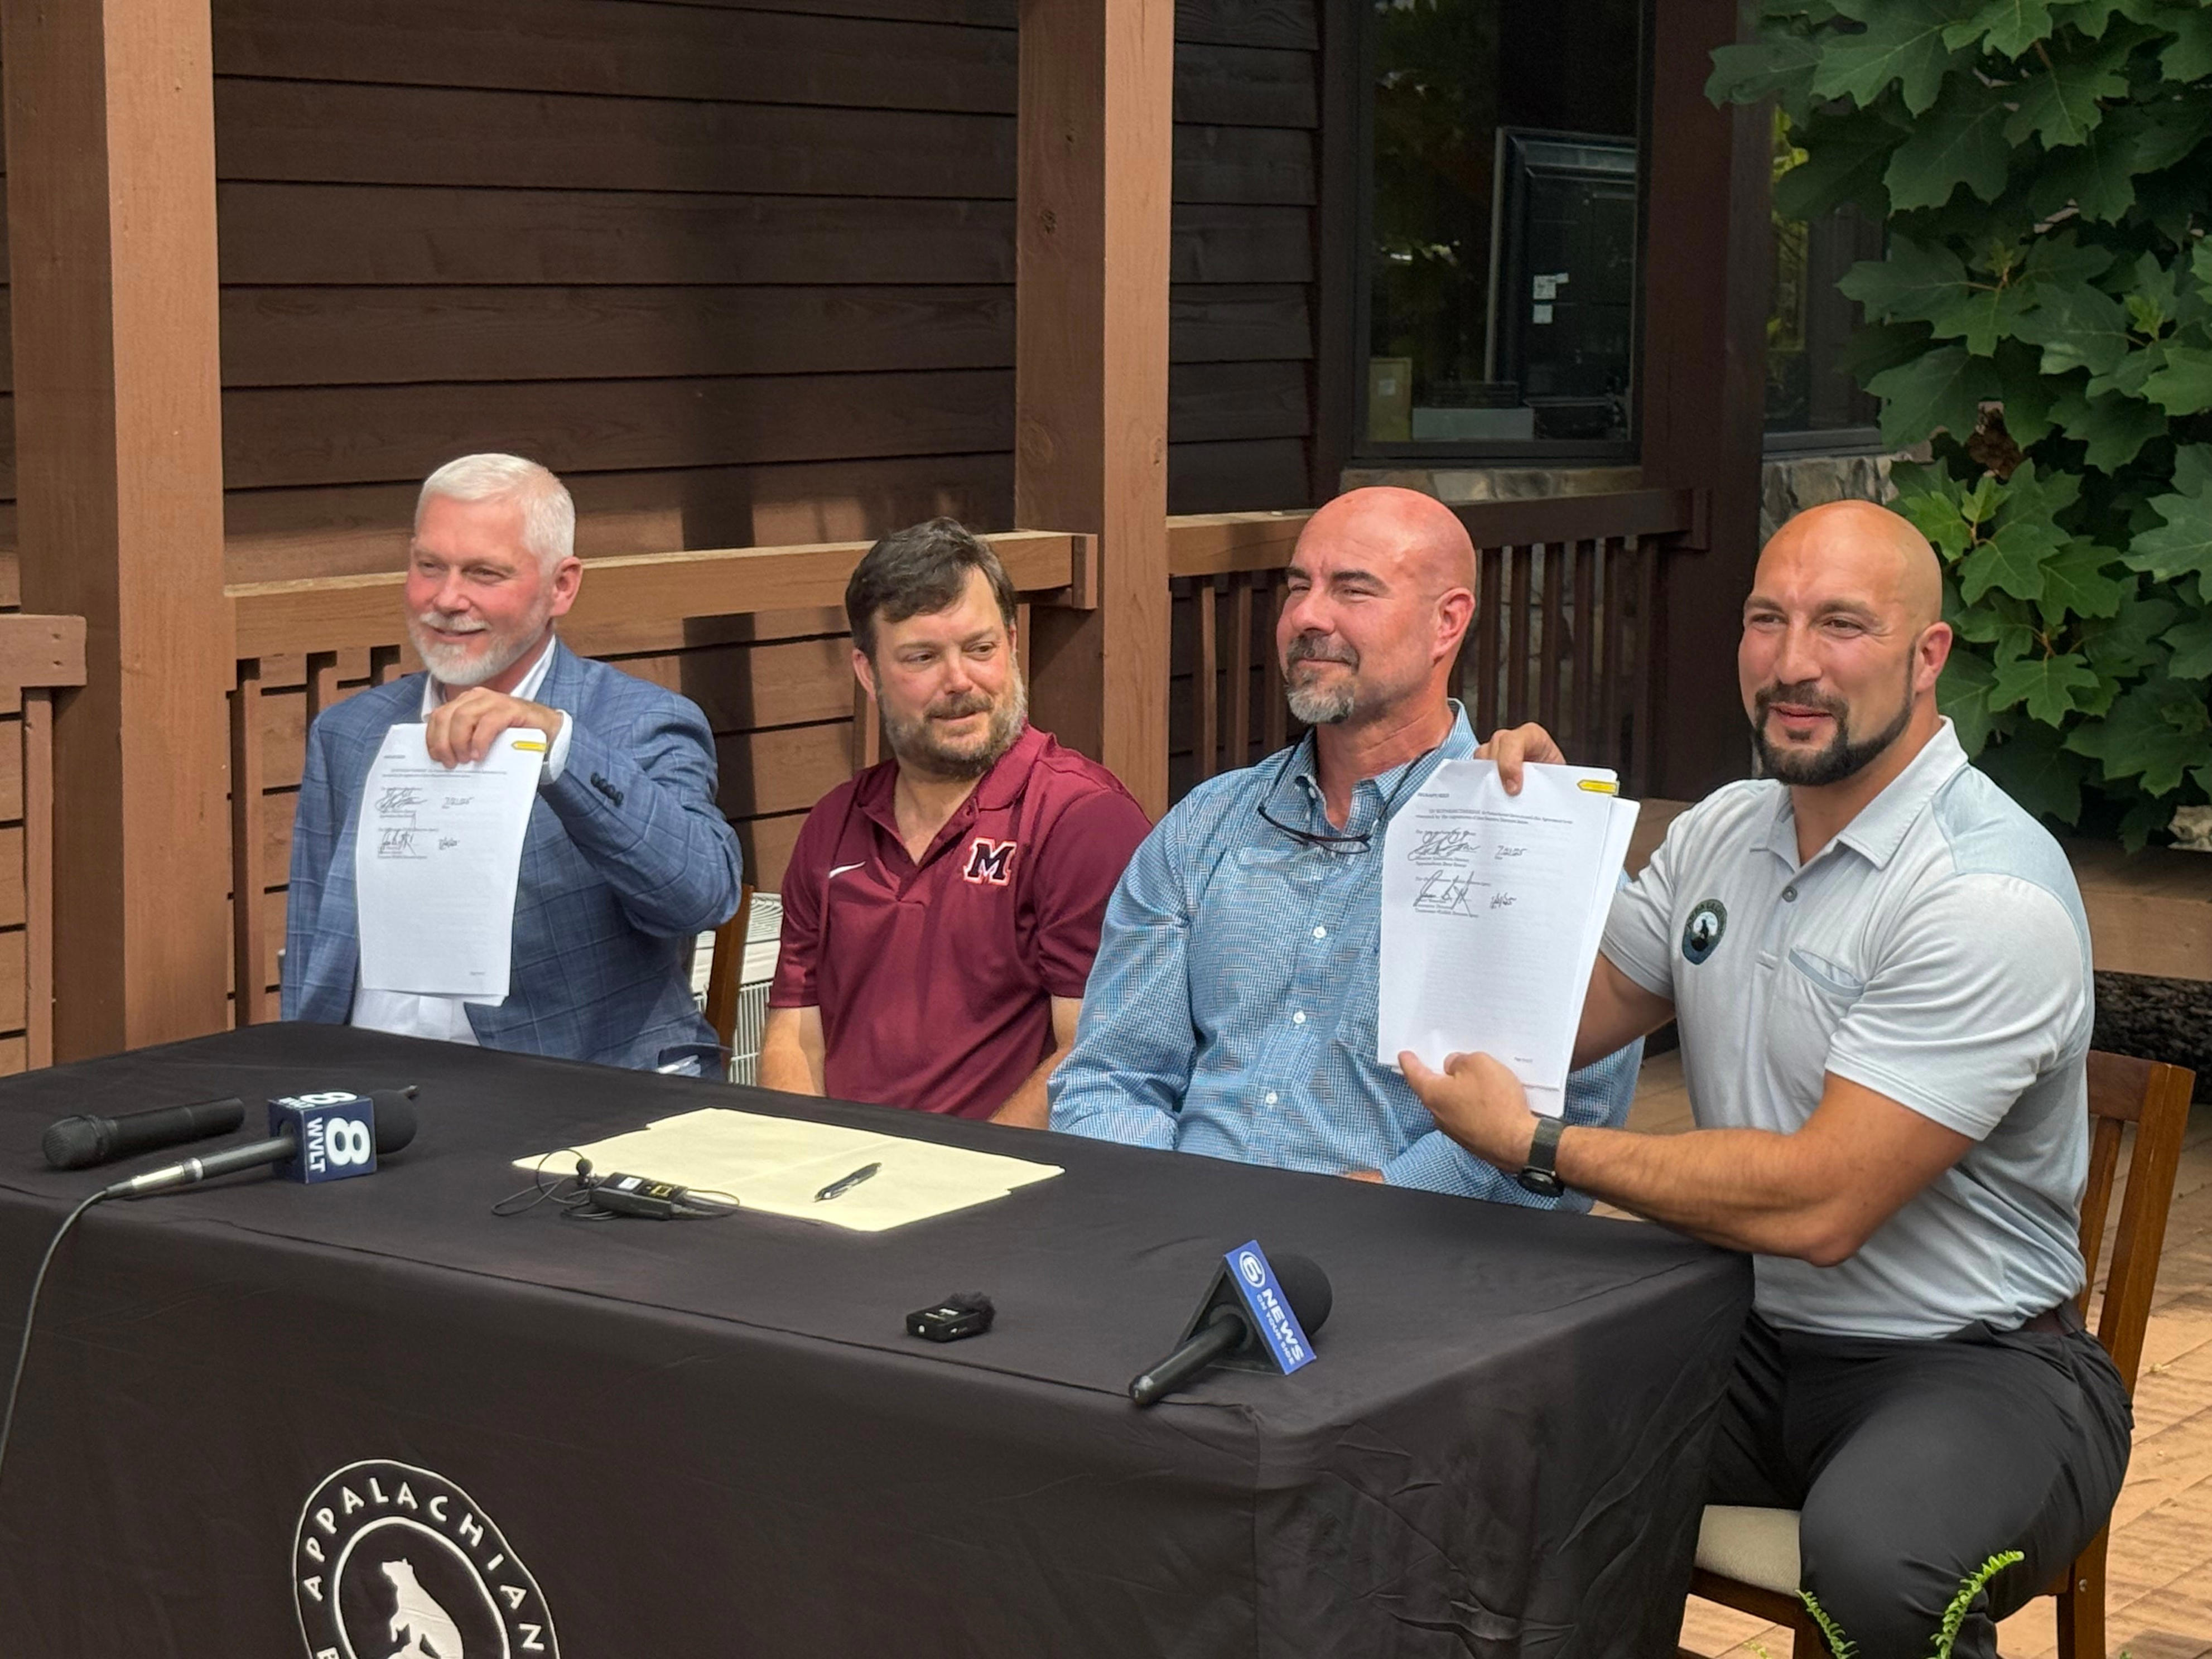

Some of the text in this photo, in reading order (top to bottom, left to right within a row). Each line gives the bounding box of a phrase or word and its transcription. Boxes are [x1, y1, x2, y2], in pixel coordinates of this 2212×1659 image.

[963, 837, 1016, 885] M
[300, 1092, 357, 1105] 8
[307, 1117, 326, 1173] WVLT
[326, 1117, 370, 1165] 8
[1243, 1256, 1304, 1361] 6 NEWS
[1257, 1294, 1295, 1366] ON YOUR SIDE
[303, 1477, 545, 1651] APPALACHIAN
